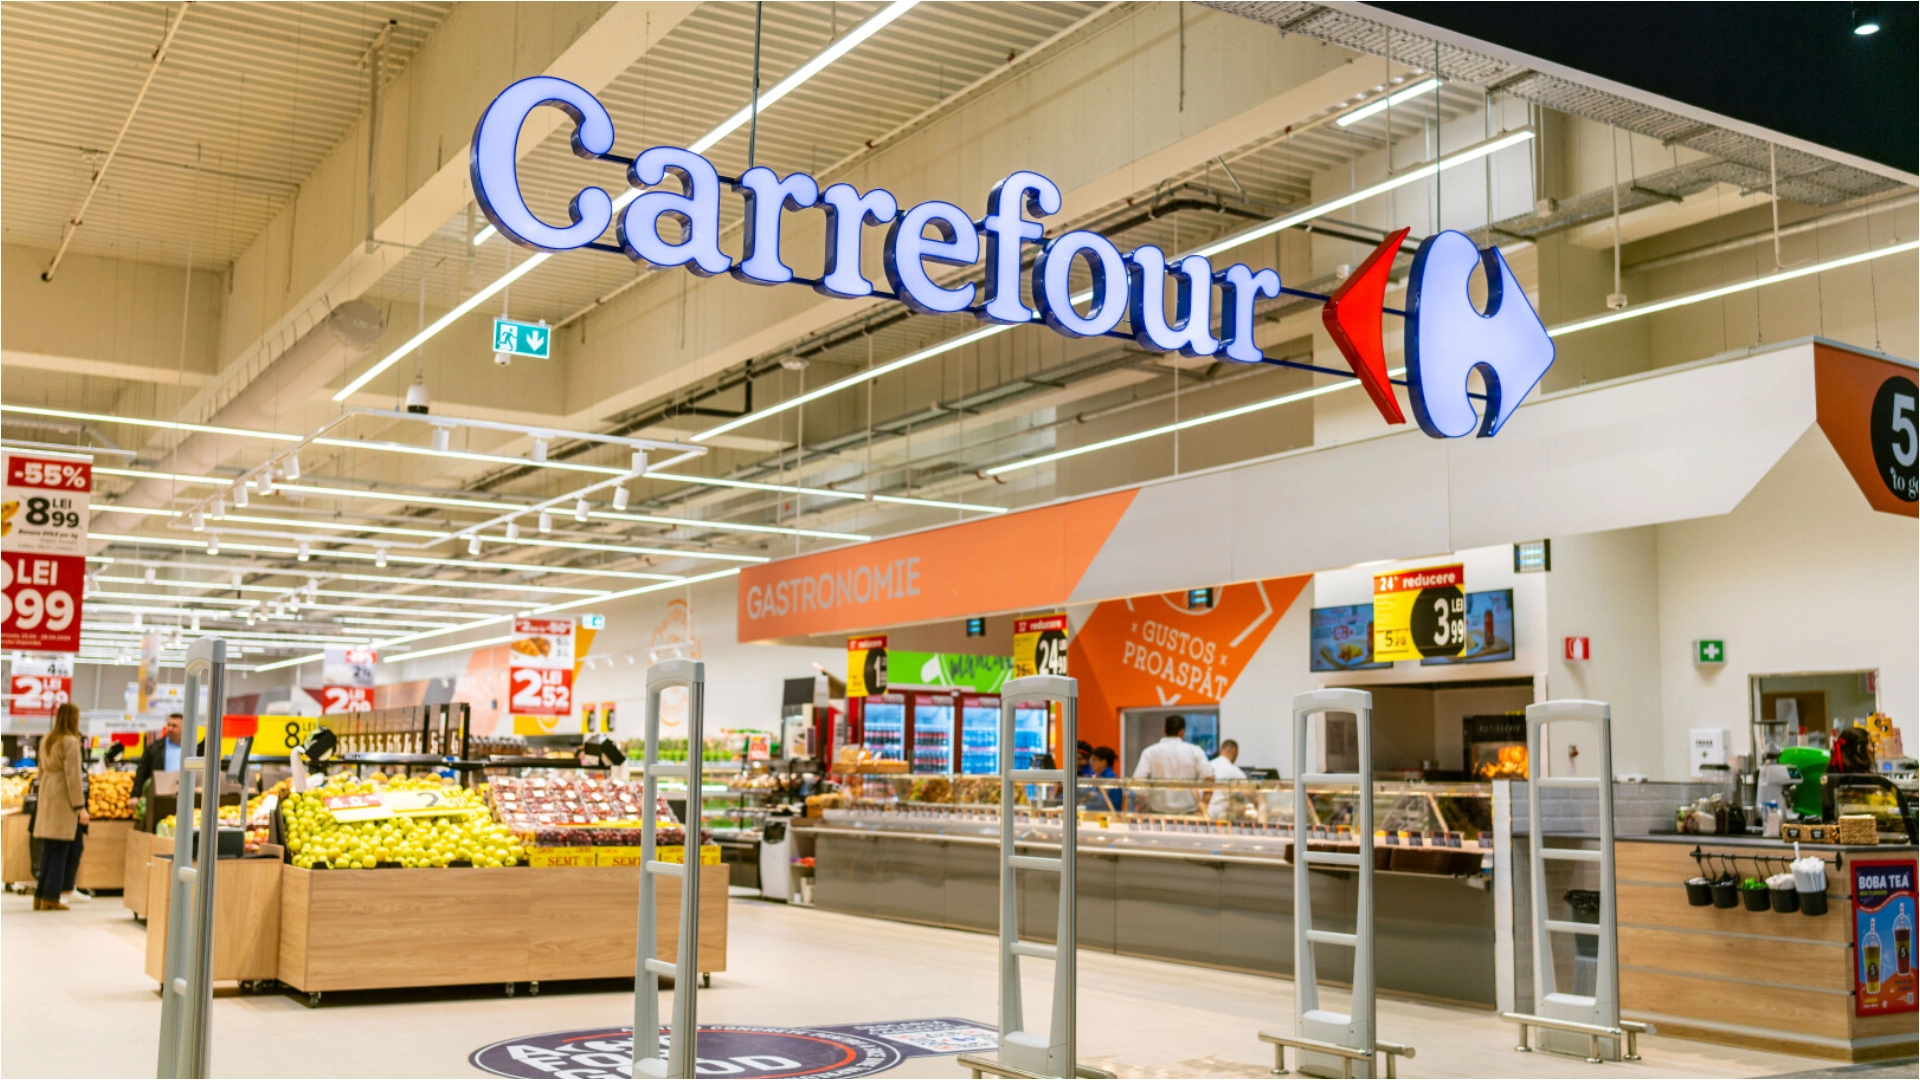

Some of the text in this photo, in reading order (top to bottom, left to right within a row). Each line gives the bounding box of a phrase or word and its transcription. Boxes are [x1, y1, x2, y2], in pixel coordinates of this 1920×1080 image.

[471, 76, 1280, 364] Carrefour
[1891, 392, 1918, 467] 5
[14, 461, 86, 488] -55%
[25, 497, 72, 525] 8 LEI
[51, 511, 79, 528] 99
[17, 558, 58, 586] LEI
[1402, 571, 1455, 588] reducere
[747, 556, 921, 619] GASTRONOMIE
[15, 588, 75, 631] 99
[1433, 597, 1449, 646] 3
[1451, 597, 1464, 613] LEI
[1142, 620, 1216, 665] GUSTOS
[1384, 630, 1393, 647] 5
[1450, 619, 1464, 644] 99
[1039, 638, 1058, 675] 24
[14, 677, 43, 708] 2
[325, 687, 349, 715] 2
[512, 668, 562, 706] 2 LEI
[541, 685, 569, 708] 52
[285, 722, 299, 748] 8
[1858, 874, 1909, 890] BOBA TEA
